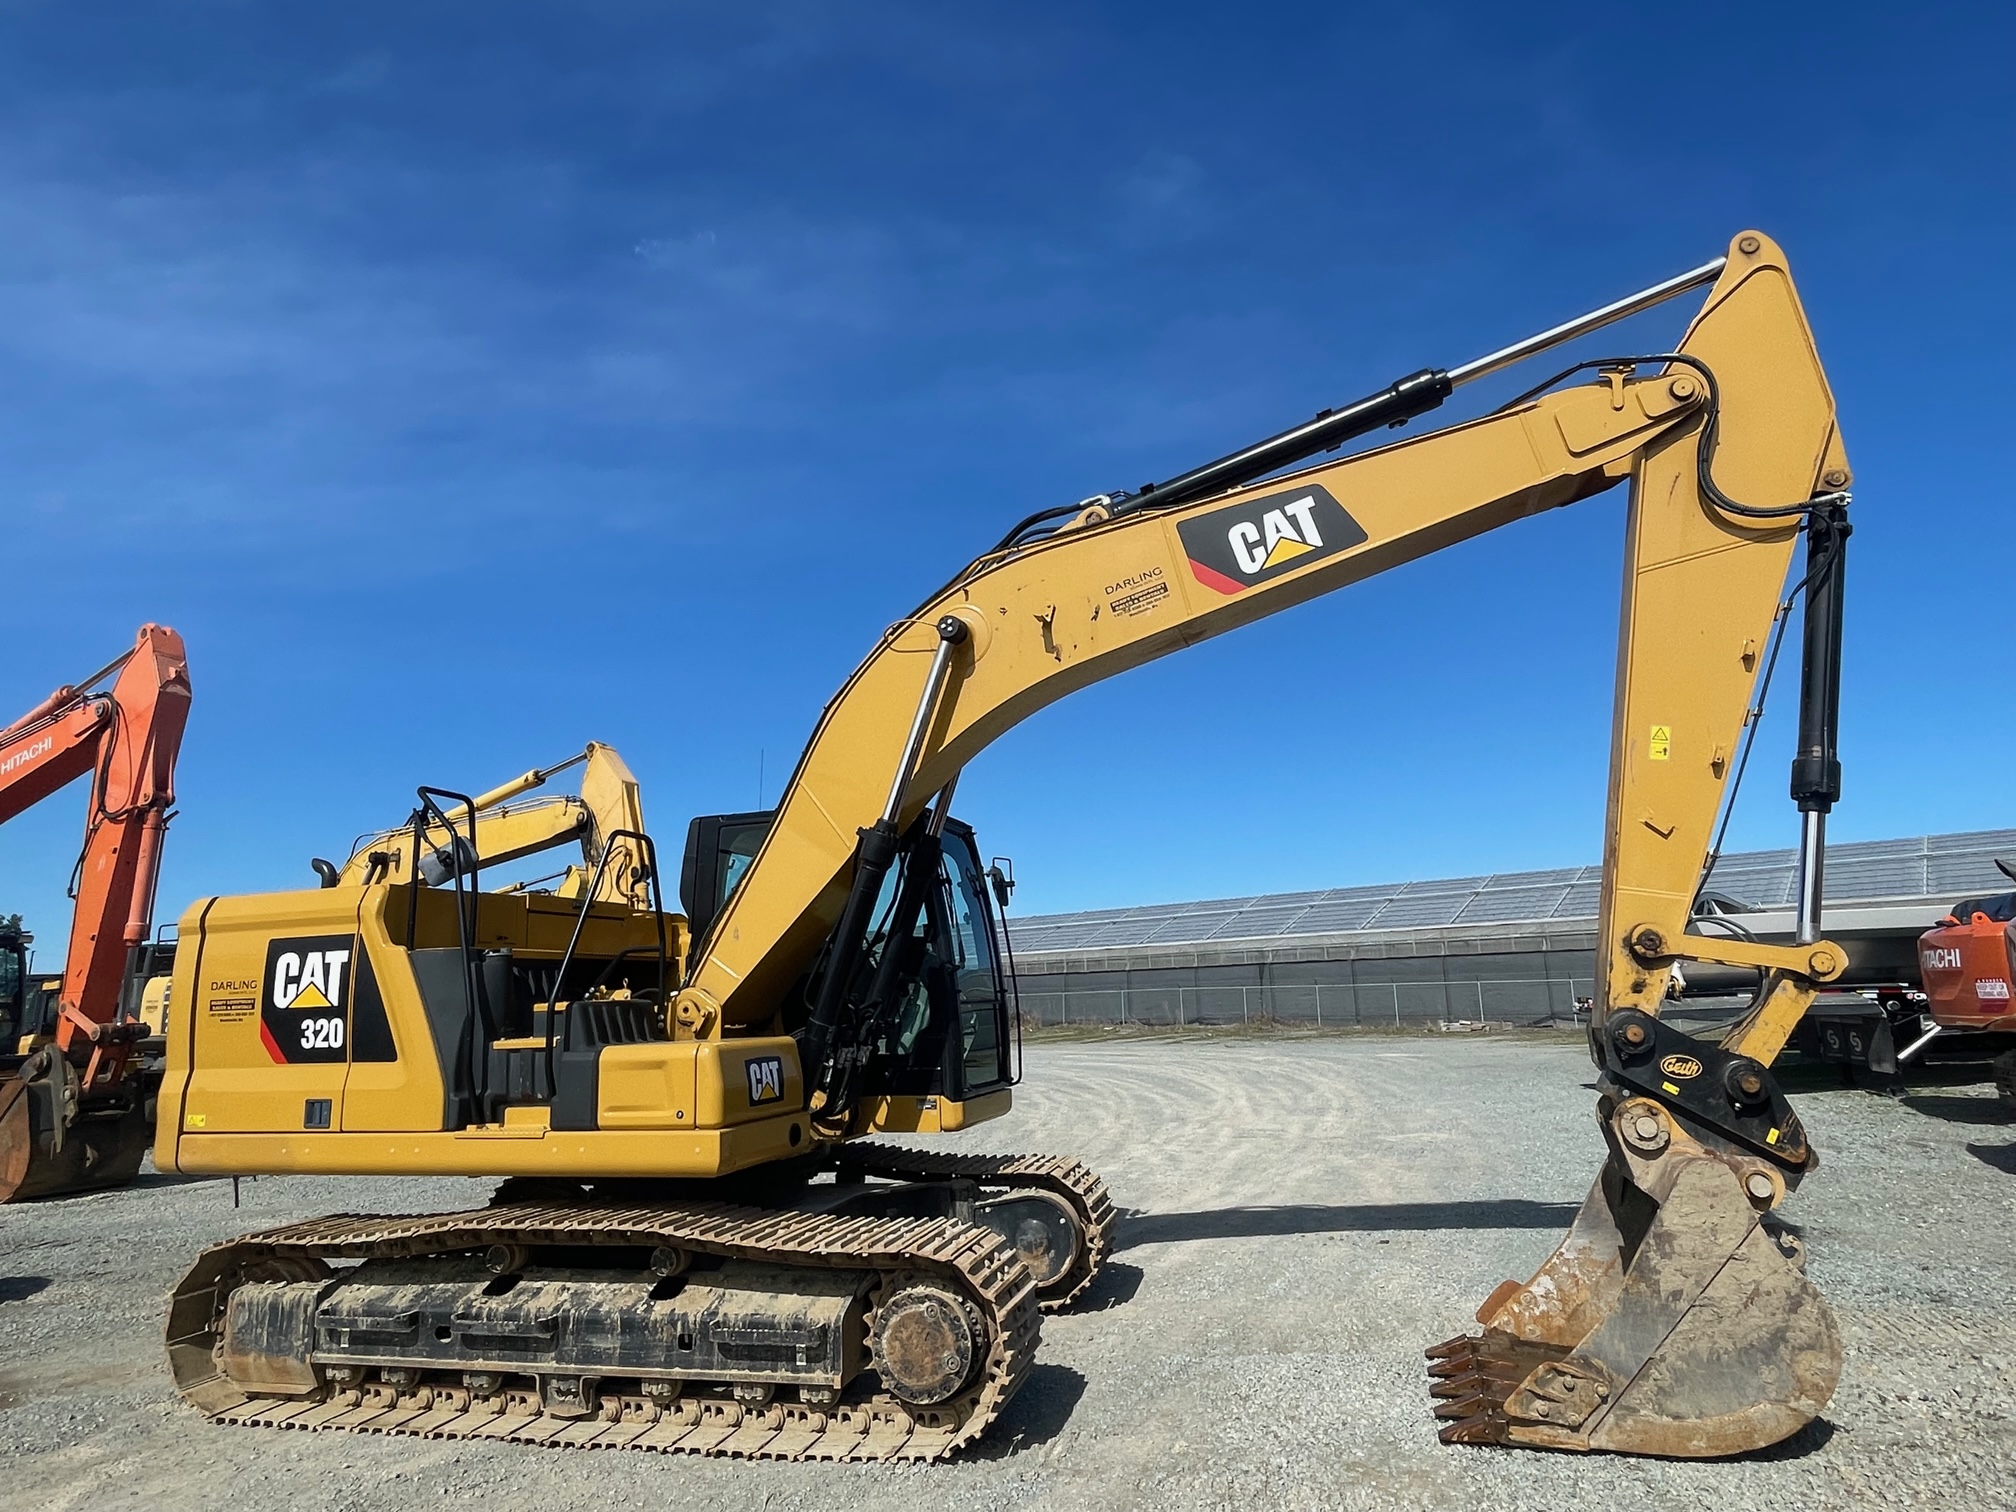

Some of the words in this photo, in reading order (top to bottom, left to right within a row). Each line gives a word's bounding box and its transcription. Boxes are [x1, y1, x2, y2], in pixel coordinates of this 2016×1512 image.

[1228, 495, 1324, 575] CAT
[1104, 566, 1163, 595] DARLING
[1, 736, 52, 775] HITACHI
[211, 980, 258, 991] DARLING
[273, 949, 350, 1009] CAT
[300, 1017, 344, 1049] 320
[749, 1061, 780, 1101] CAT
